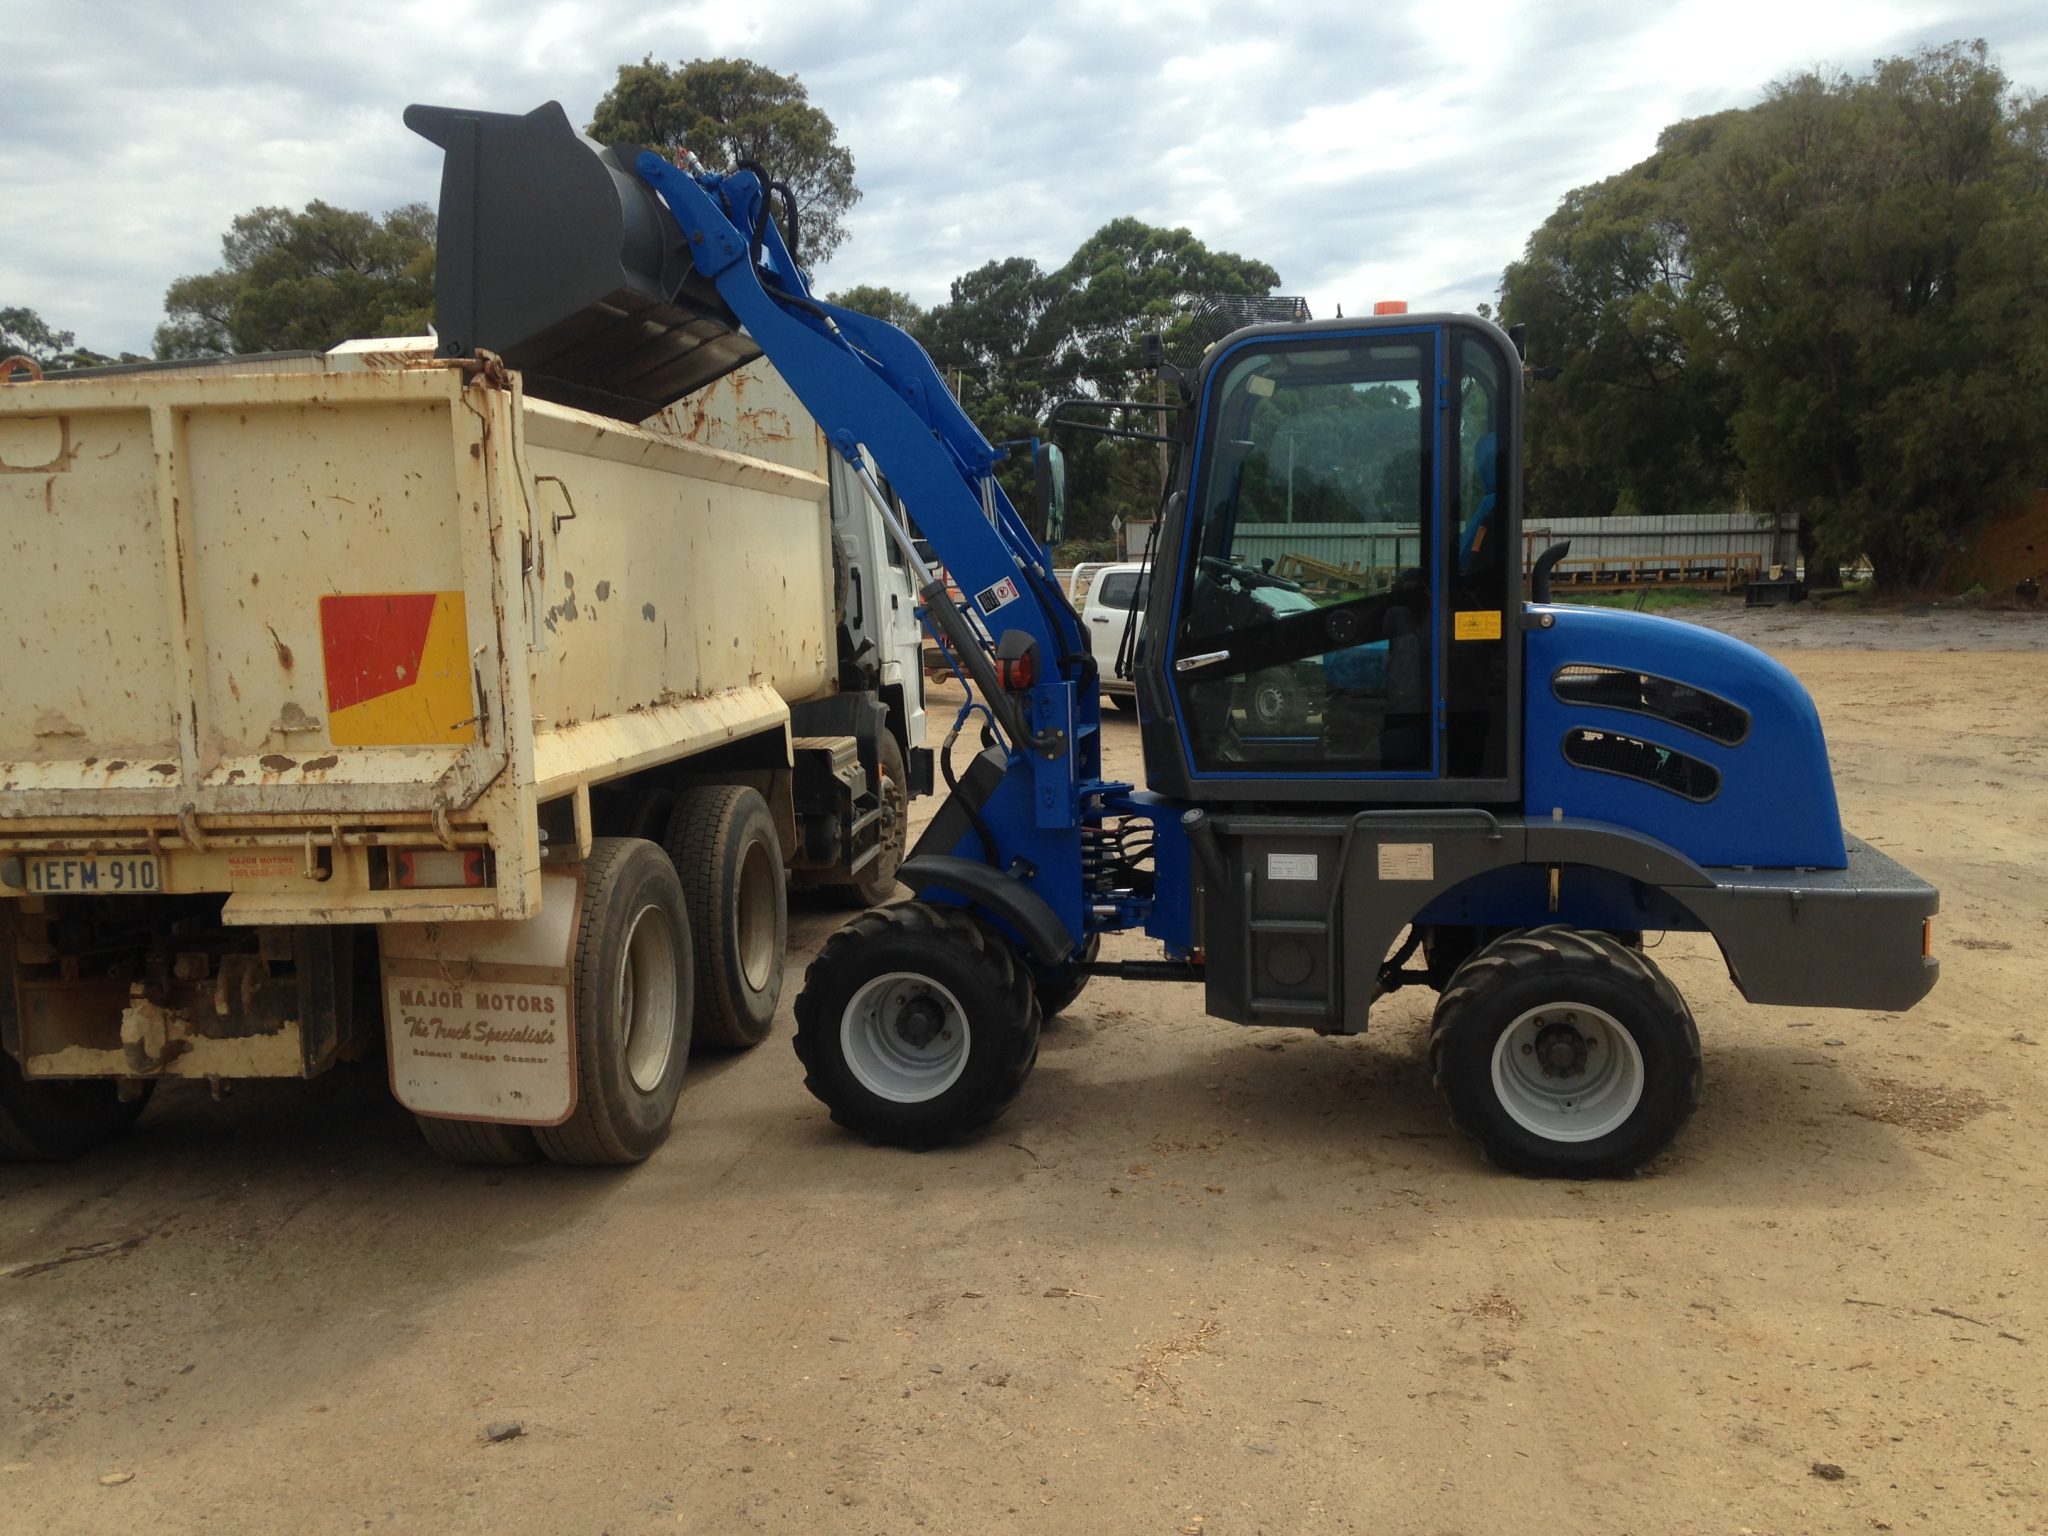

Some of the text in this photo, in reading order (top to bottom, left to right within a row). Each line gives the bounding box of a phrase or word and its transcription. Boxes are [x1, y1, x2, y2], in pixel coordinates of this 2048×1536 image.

[400, 990, 555, 1014] MAJOR MOTORS
[430, 1018, 471, 1040] Truck
